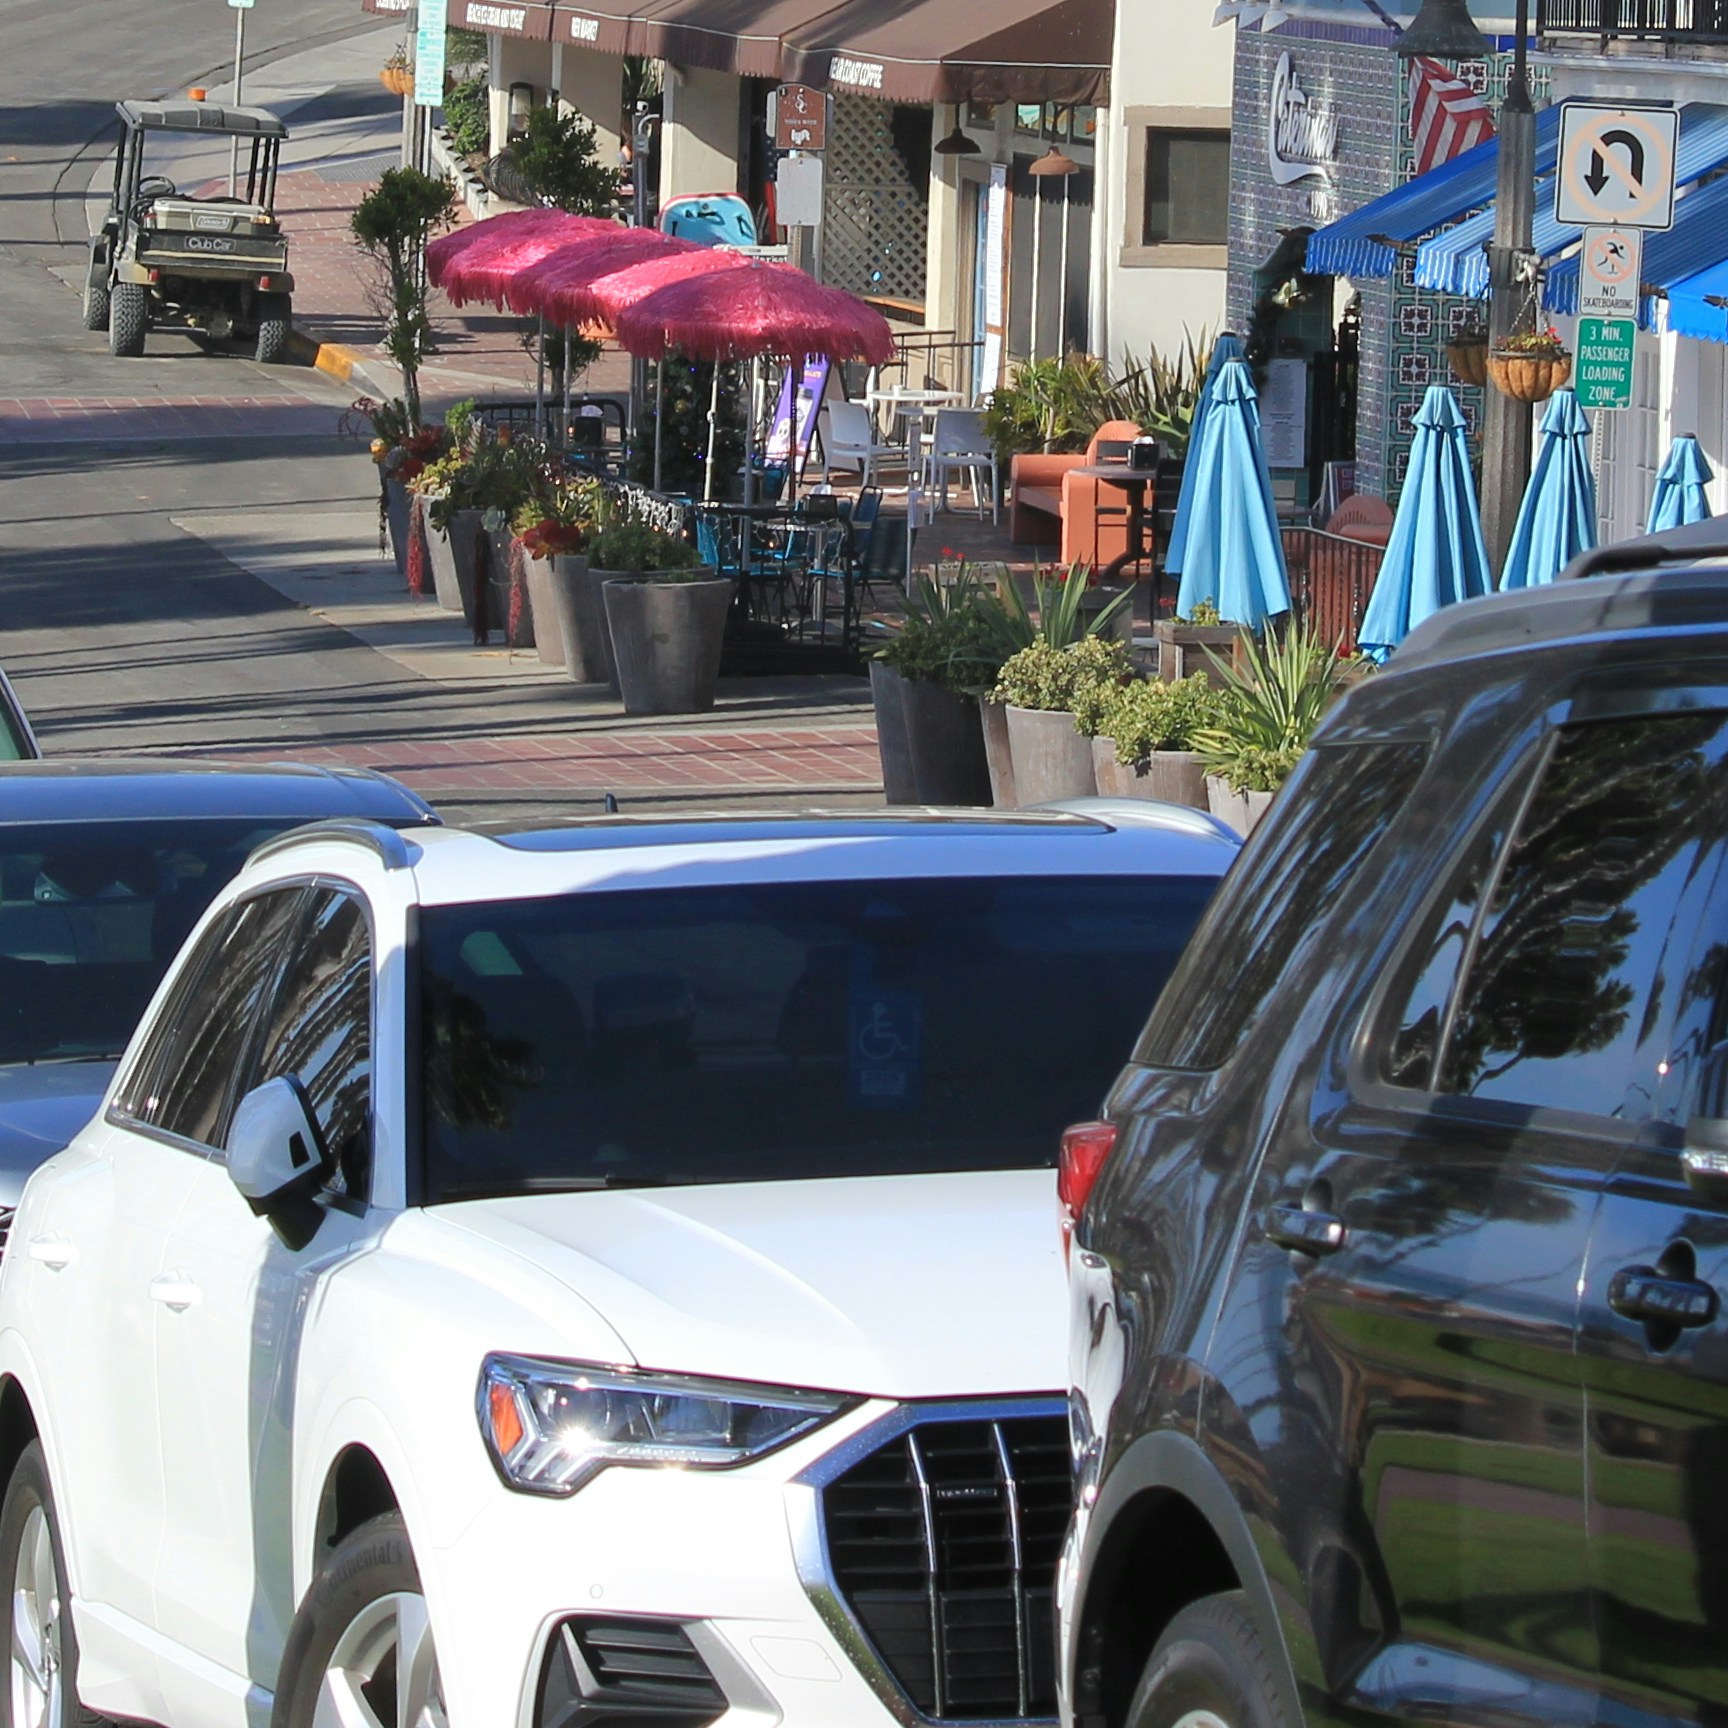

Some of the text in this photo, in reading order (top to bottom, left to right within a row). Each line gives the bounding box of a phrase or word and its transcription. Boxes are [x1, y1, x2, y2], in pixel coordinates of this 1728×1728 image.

[189, 237, 232, 250] Club Car
[1602, 285, 1616, 297] NO
[1583, 297, 1634, 309] SKATEBOARDING
[1589, 326, 1623, 342] 3 MIN.
[1580, 345, 1630, 362] PASSENGER
[1581, 365, 1626, 382] LOADING
[1588, 385, 1617, 401] ZONE
